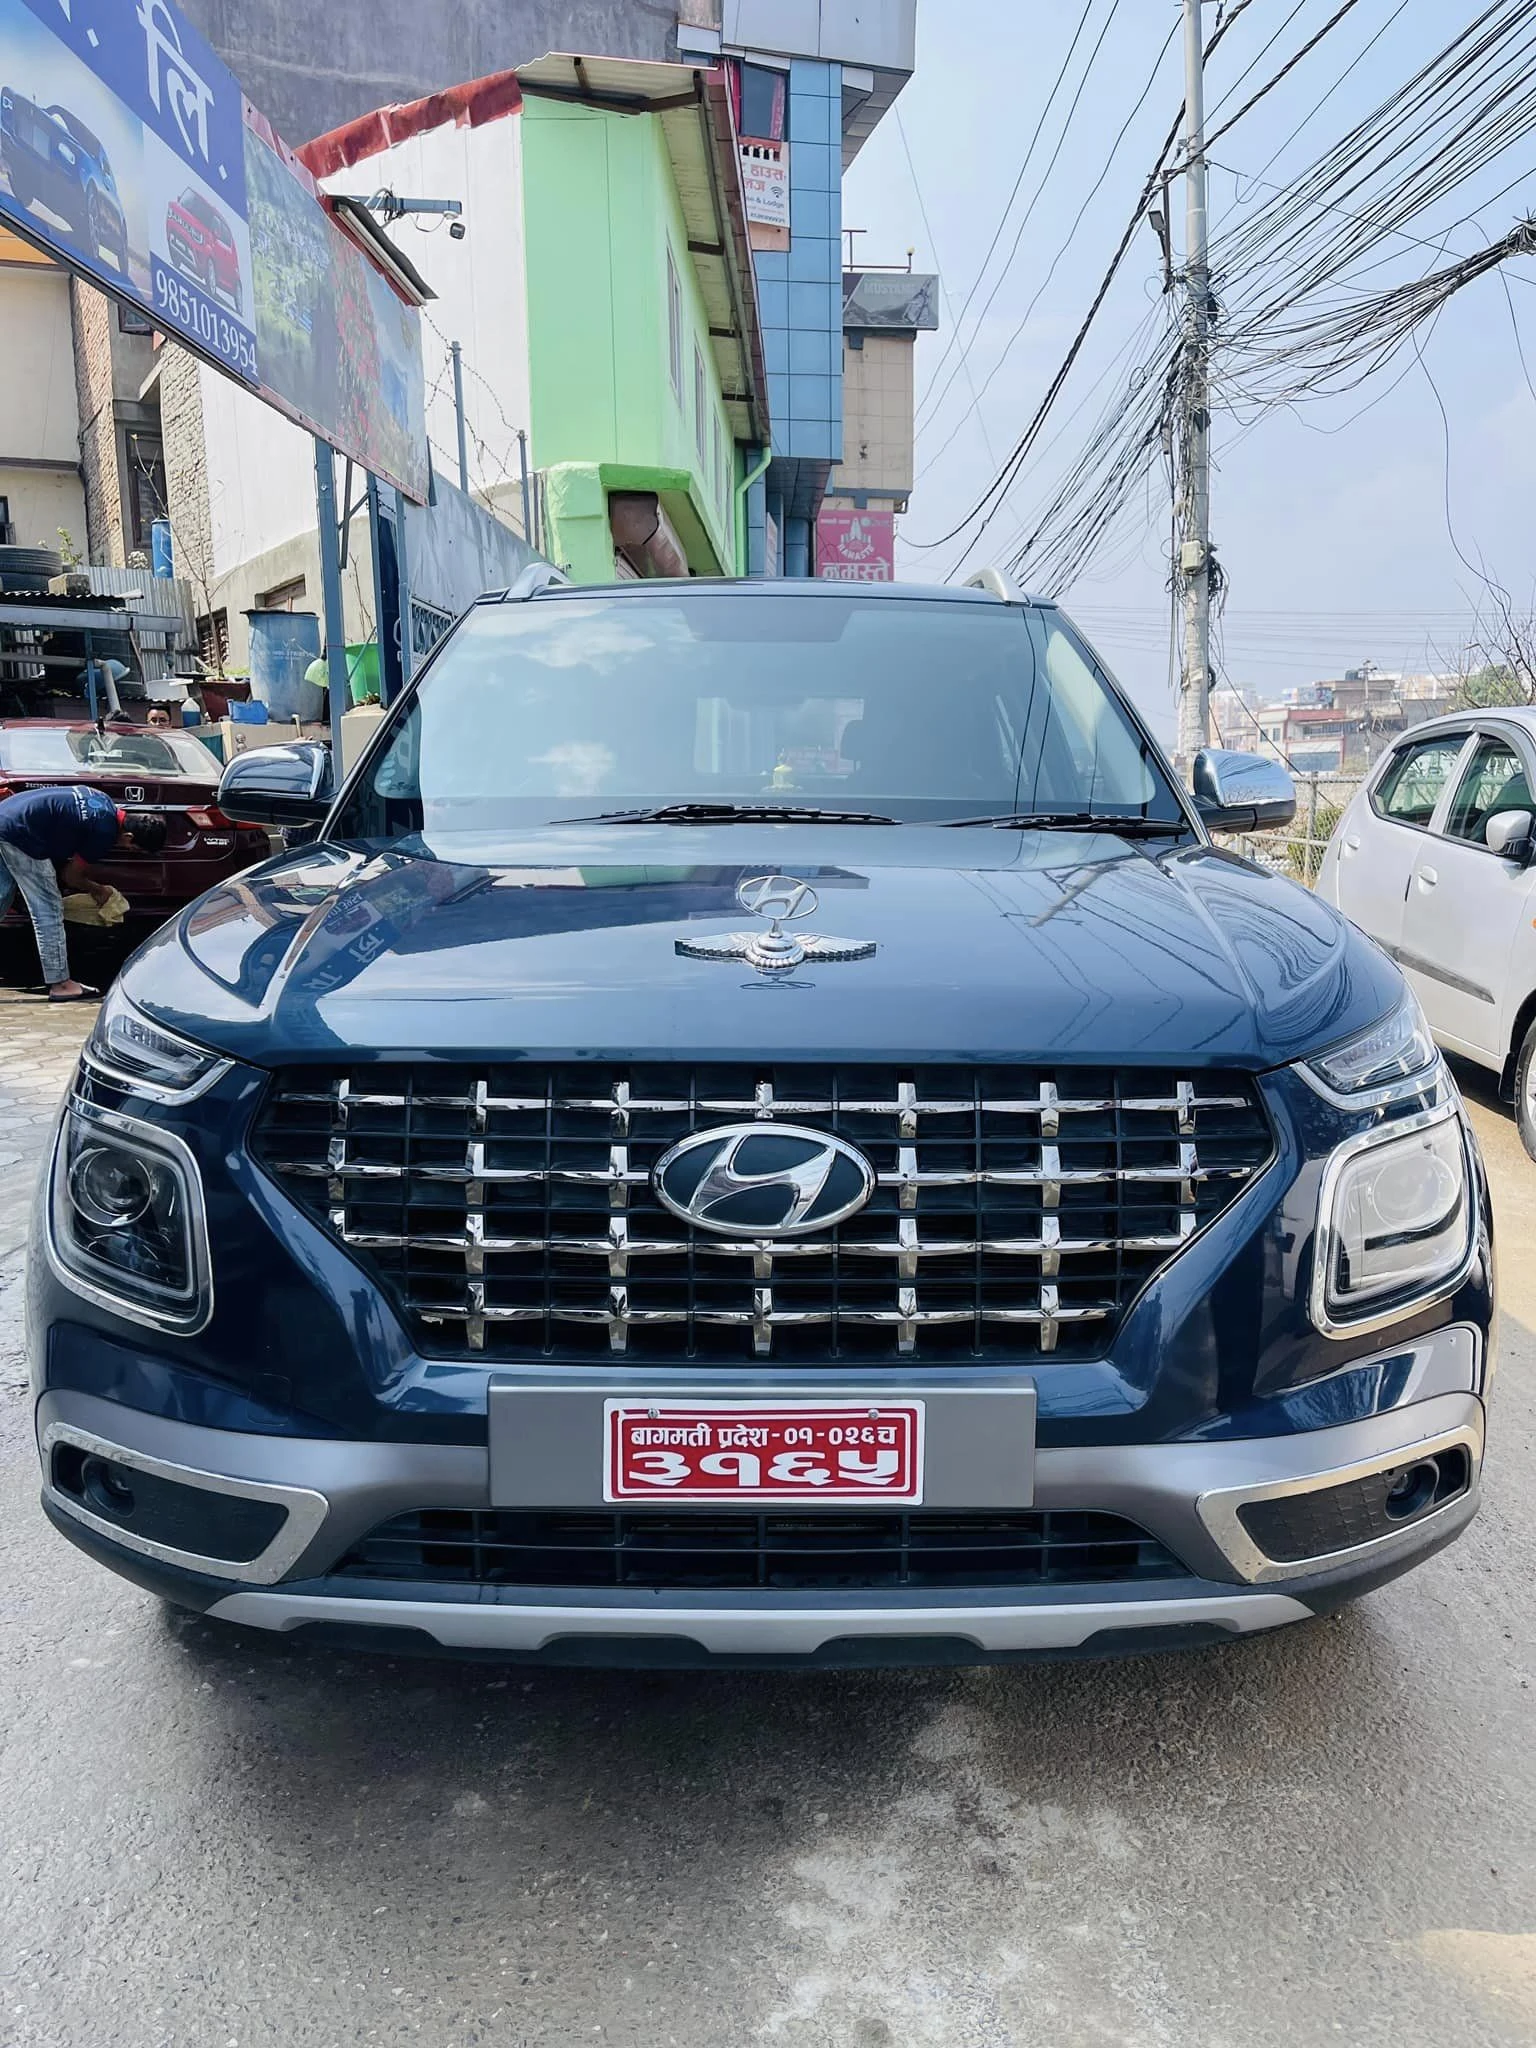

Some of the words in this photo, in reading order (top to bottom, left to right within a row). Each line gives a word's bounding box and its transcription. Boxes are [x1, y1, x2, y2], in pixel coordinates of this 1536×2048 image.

[156, 269, 258, 377] 9851013954
[837, 543, 875, 560] NAMASTE
[631, 1423, 712, 1447] बागमती
[628, 1450, 899, 1486] ३१६५
